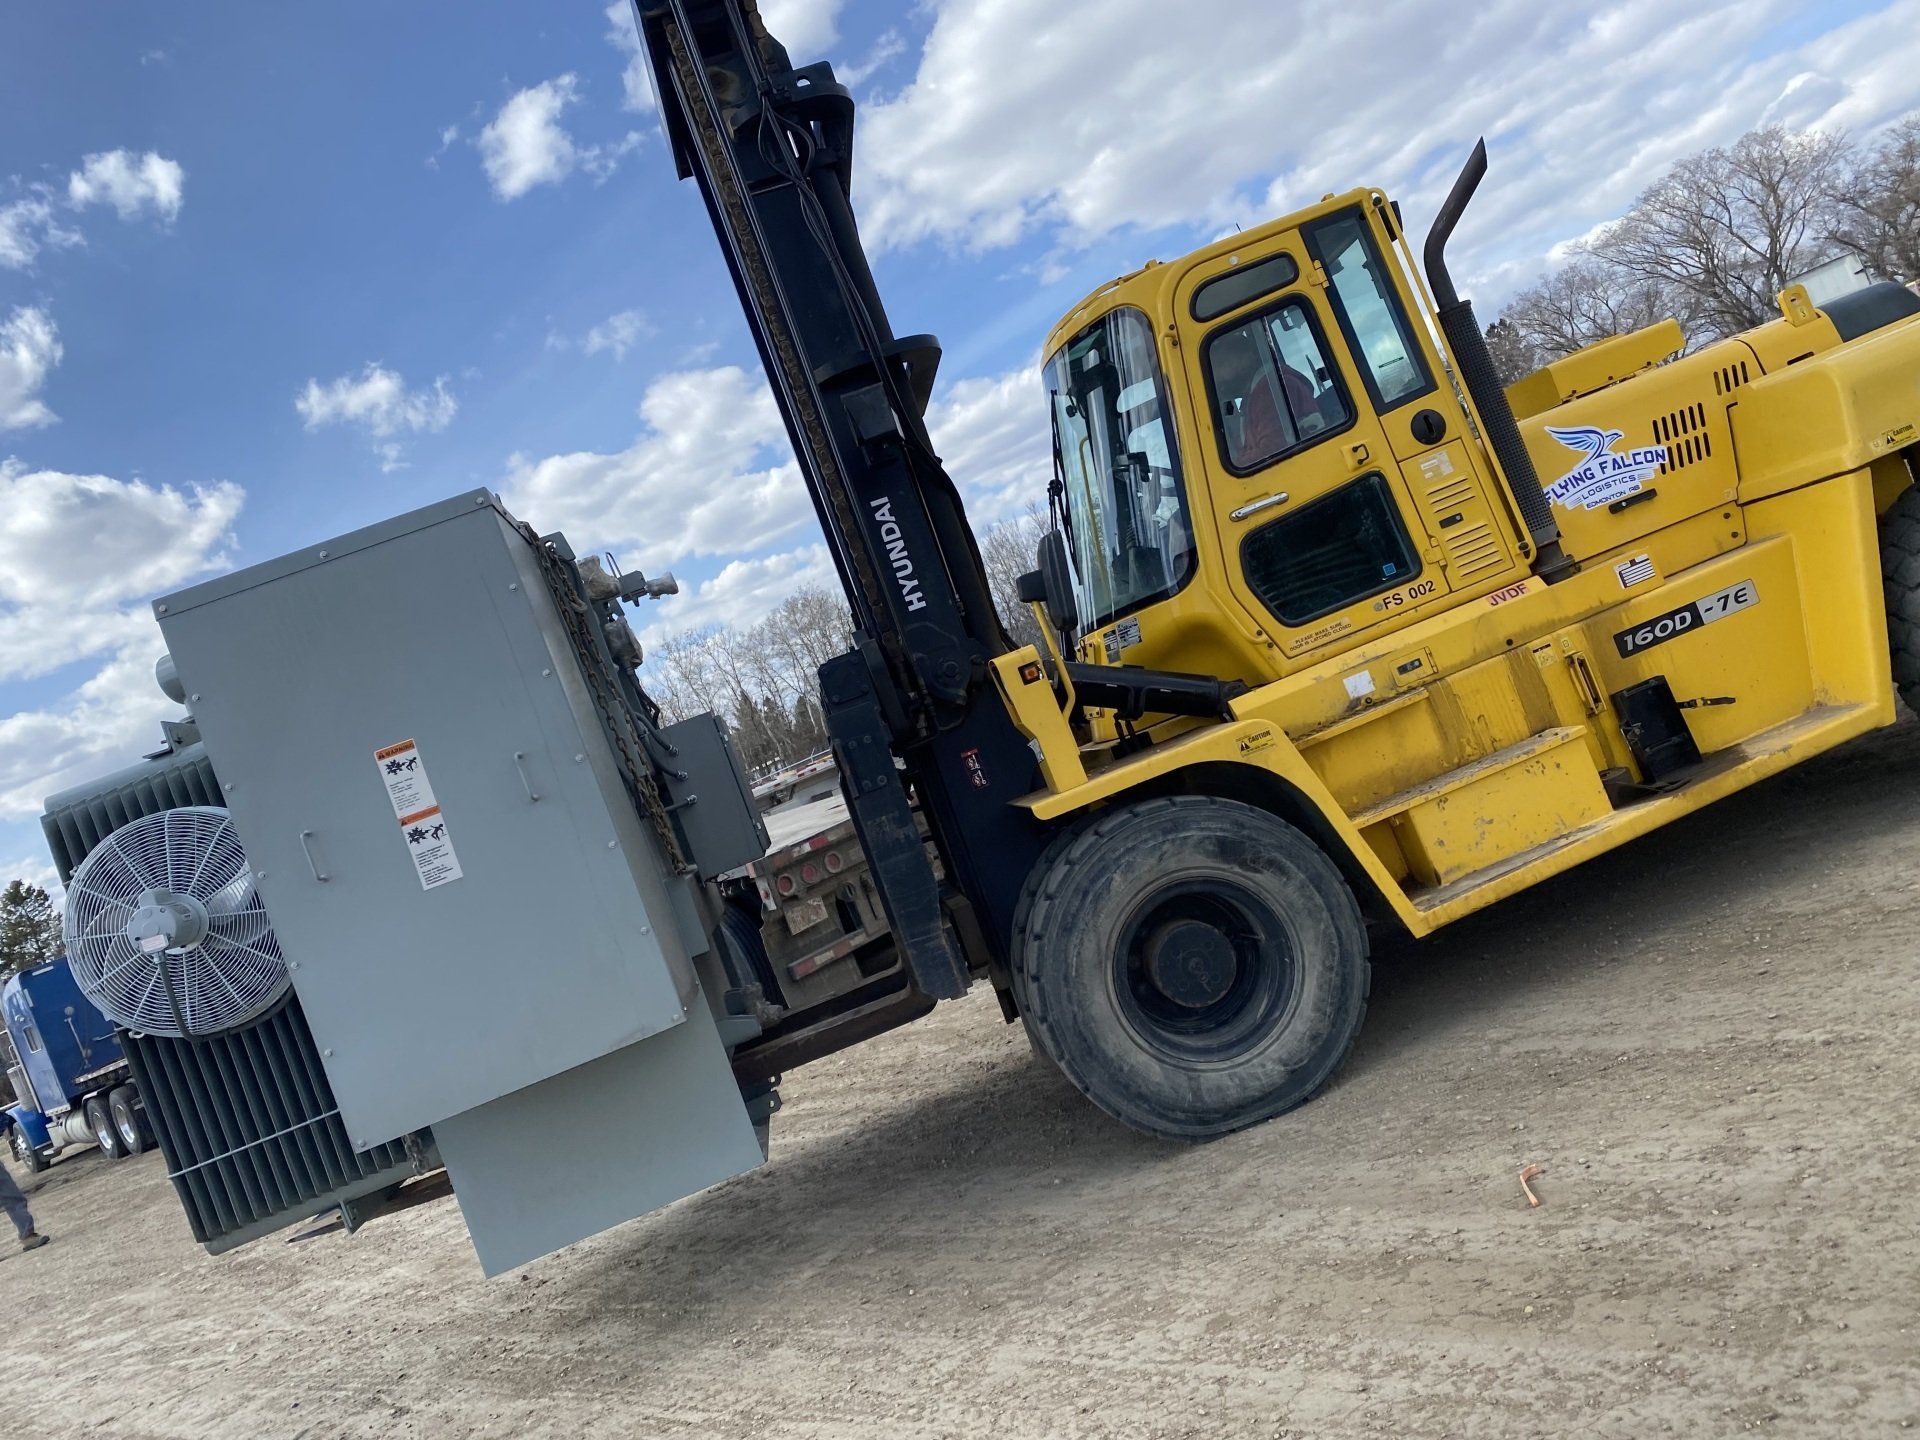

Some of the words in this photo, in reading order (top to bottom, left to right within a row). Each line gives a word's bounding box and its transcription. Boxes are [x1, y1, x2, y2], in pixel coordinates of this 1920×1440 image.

[1544, 466, 1596, 506] FLYING
[1598, 448, 1666, 476] FALCON
[1581, 474, 1637, 500] LOGISTICS
[1586, 489, 1627, 509] EDMONTON
[870, 496, 927, 612] HYUNDAI
[1382, 592, 1404, 610] FS
[1408, 580, 1436, 599] 002
[1489, 582, 1529, 607] JVDF
[1247, 729, 1271, 744] CAUTION
